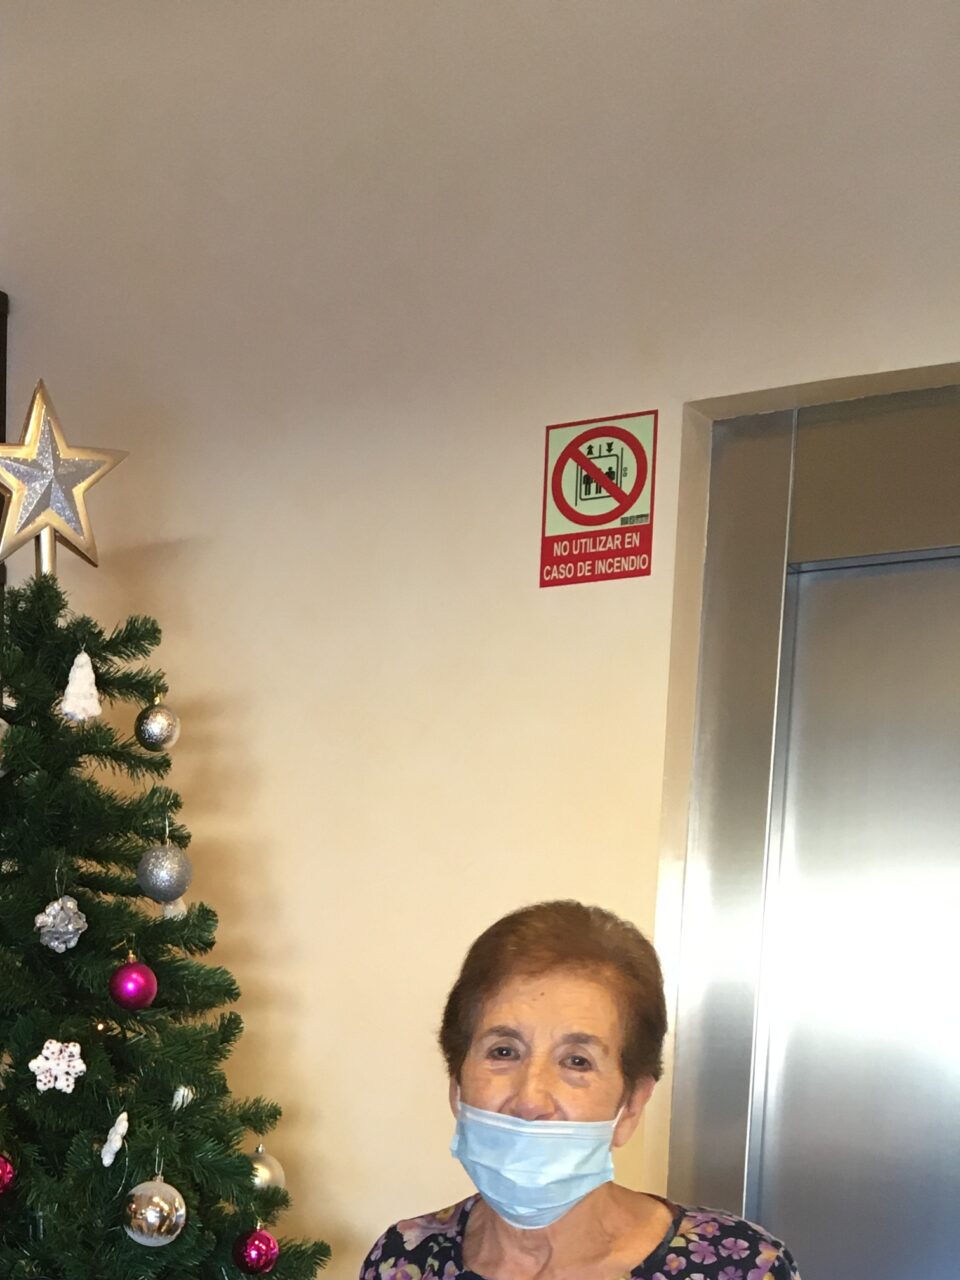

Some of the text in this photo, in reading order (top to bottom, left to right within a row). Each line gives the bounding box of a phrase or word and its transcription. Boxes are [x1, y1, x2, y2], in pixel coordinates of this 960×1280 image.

[553, 532, 640, 556] NO UTILIZAR EN
[543, 554, 649, 580] CASO DE INCENDIO
